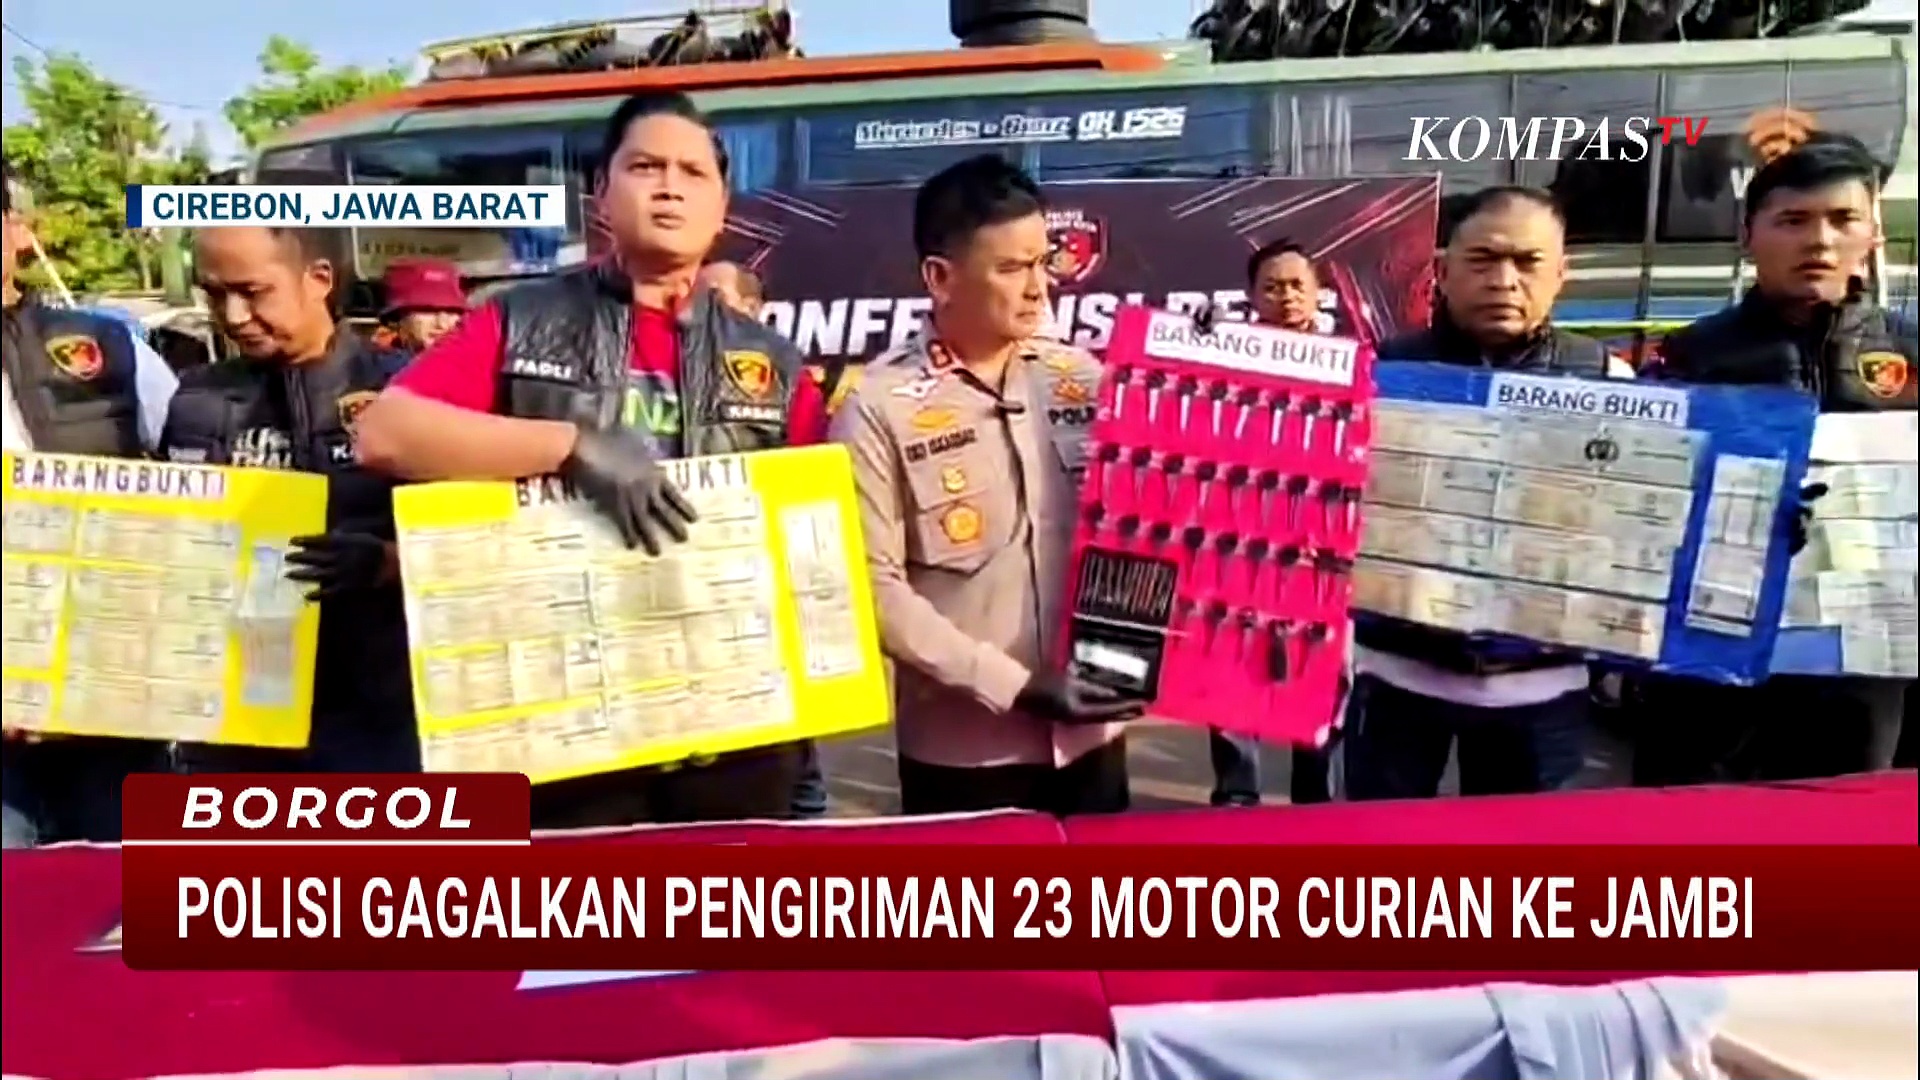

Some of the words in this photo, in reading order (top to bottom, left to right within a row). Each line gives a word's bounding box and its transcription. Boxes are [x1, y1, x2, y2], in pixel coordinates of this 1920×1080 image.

[1152, 321, 1262, 358] BARANG
[1271, 339, 1350, 373] BUKTI
[1498, 383, 1596, 413] BARANG
[1603, 393, 1679, 421] BUKTI
